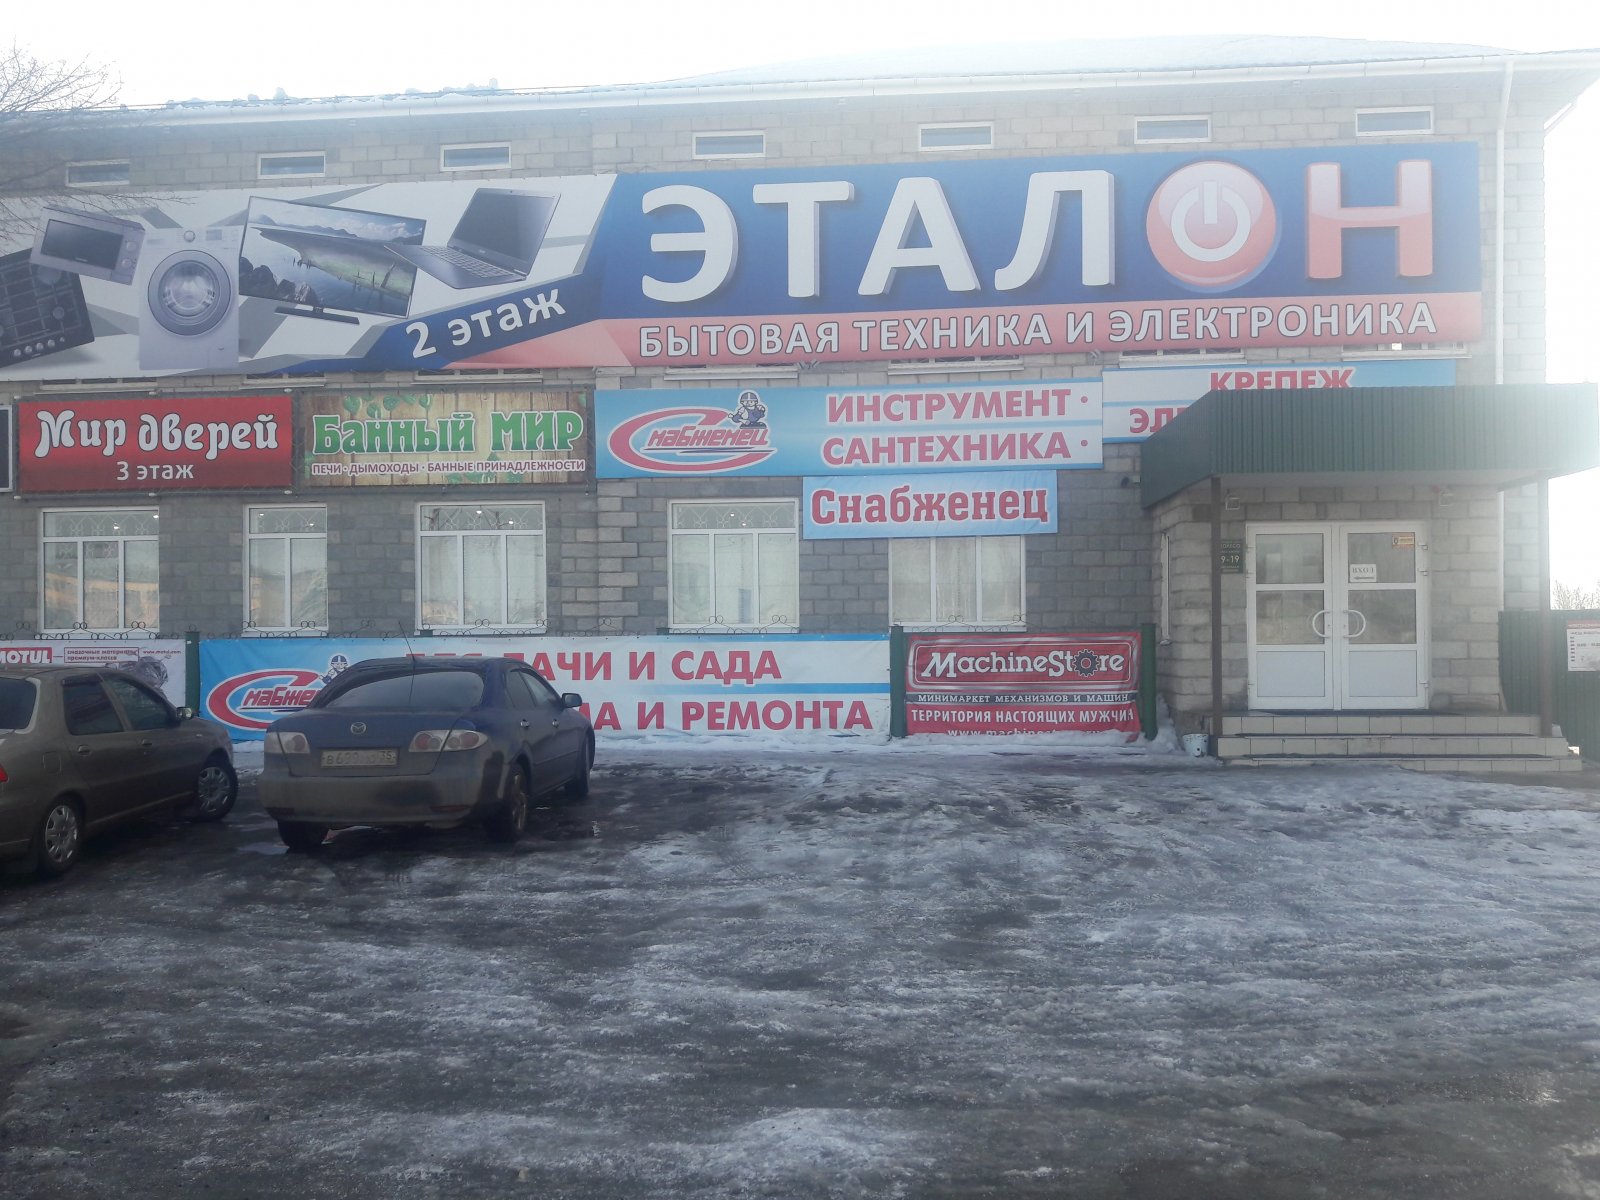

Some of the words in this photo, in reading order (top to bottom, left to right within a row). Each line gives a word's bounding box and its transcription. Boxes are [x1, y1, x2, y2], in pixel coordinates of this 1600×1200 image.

[641, 160, 1434, 303] ЭТАЛОН
[405, 321, 438, 359] 2
[450, 287, 566, 347] этаж
[640, 317, 839, 358] БЫТОВАЯ
[853, 314, 1051, 351] ТЕХНИКА
[1067, 311, 1095, 344] И
[1108, 302, 1437, 343] ЭЛЕКТРОНИКА
[828, 389, 1071, 423] ИНСТРУМЕНТ
[34, 409, 127, 458] Мир
[137, 413, 279, 460] дверей
[312, 412, 476, 454] Банный
[490, 410, 584, 451] МИР
[822, 431, 1071, 465] САНТЕХНИКА
[116, 461, 130, 480] 3
[136, 464, 194, 480] этаж
[312, 463, 342, 475] ПЕЧИ
[350, 462, 419, 475] ДЫМОХОДЫ
[427, 462, 473, 472] БАННЫЕ
[476, 460, 585, 473] ПРИНАДЛЕЖНОСТИ
[812, 485, 1048, 525] Снабженец
[629, 651, 655, 680] И
[671, 650, 782, 684] САДА
[918, 694, 990, 703] МИНИМАРКЕТ
[995, 694, 1069, 703] МЕХАНИЗМОВ
[1073, 694, 1081, 702] И
[1087, 693, 1128, 702] МАШИН
[637, 702, 664, 730] И
[682, 700, 873, 731] РЕМОНТА
[912, 709, 991, 723] ТЕРРИТОРИЯ
[996, 710, 1075, 724] НАСТОЯЩИХ
[1079, 708, 1134, 723] МУЖЧИН
